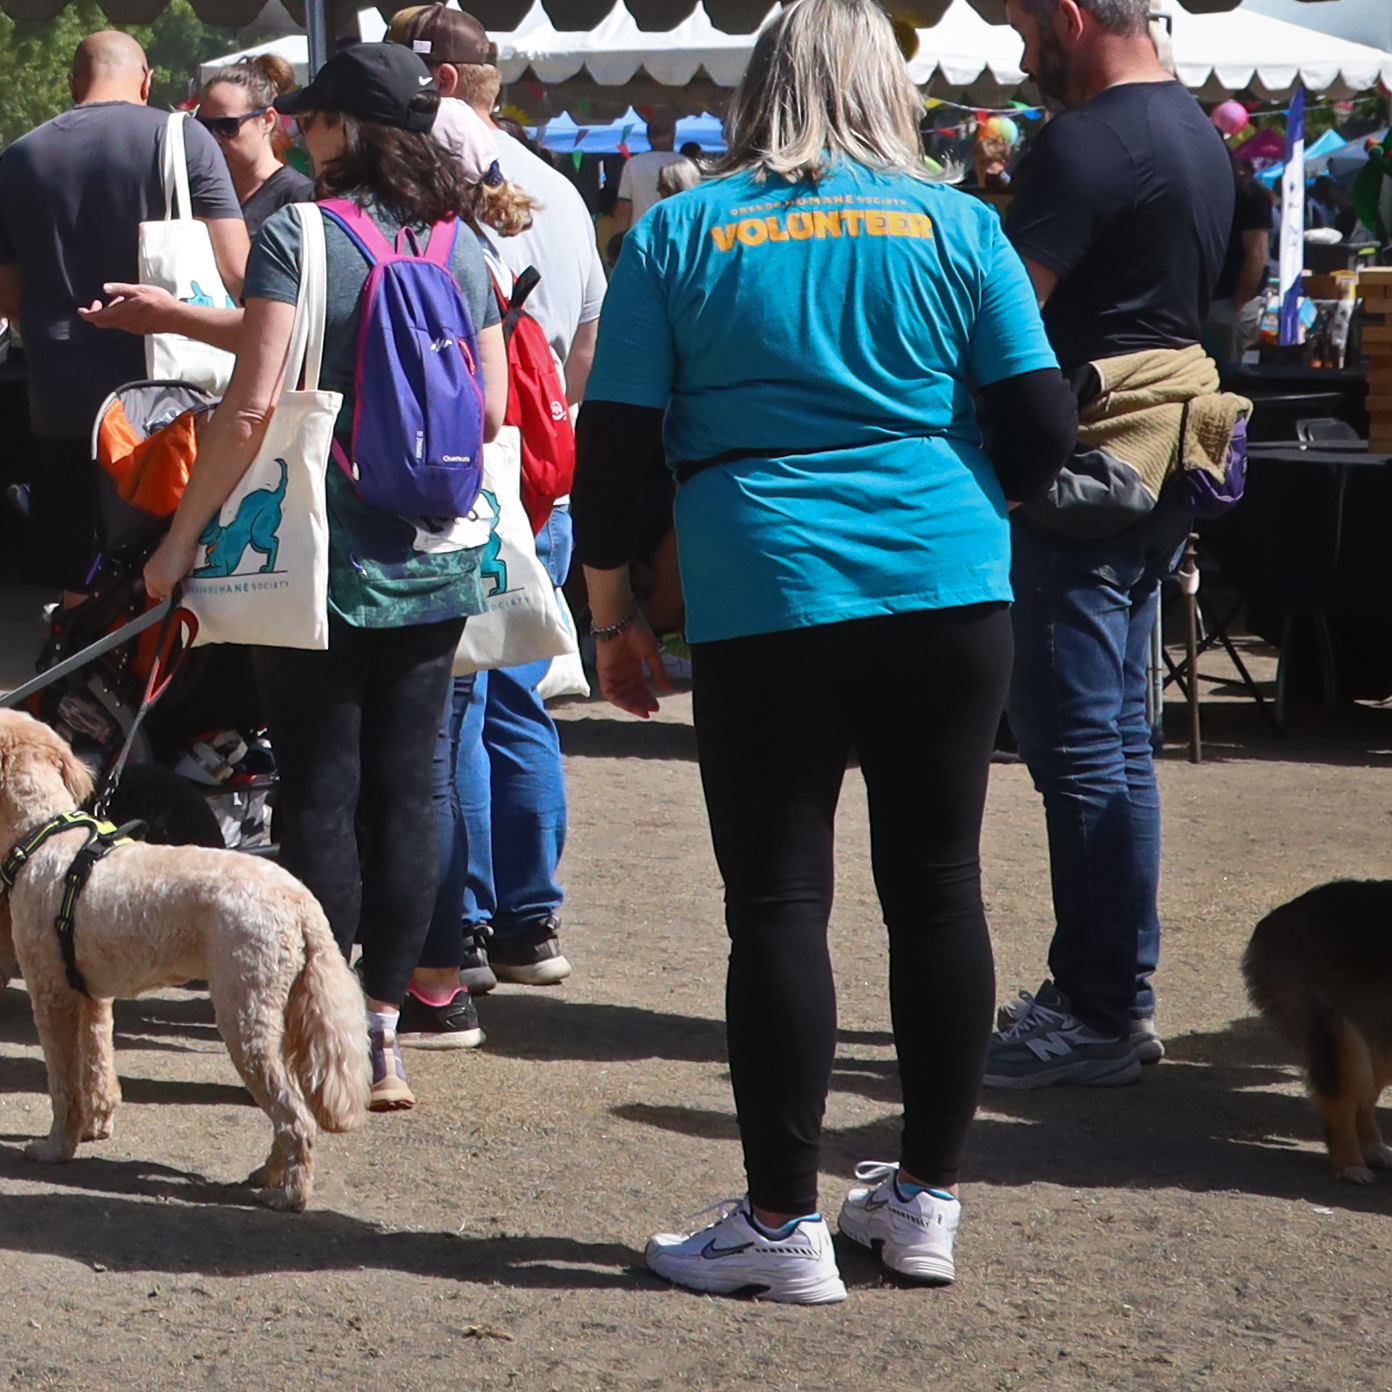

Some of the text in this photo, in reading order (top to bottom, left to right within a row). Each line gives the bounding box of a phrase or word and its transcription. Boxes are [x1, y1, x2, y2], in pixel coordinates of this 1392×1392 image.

[784, 194, 854, 208] HUMANE
[710, 209, 934, 253] VOLUNTEER
[251, 581, 289, 591] SOCIETY
[490, 595, 531, 611] OCIETY
